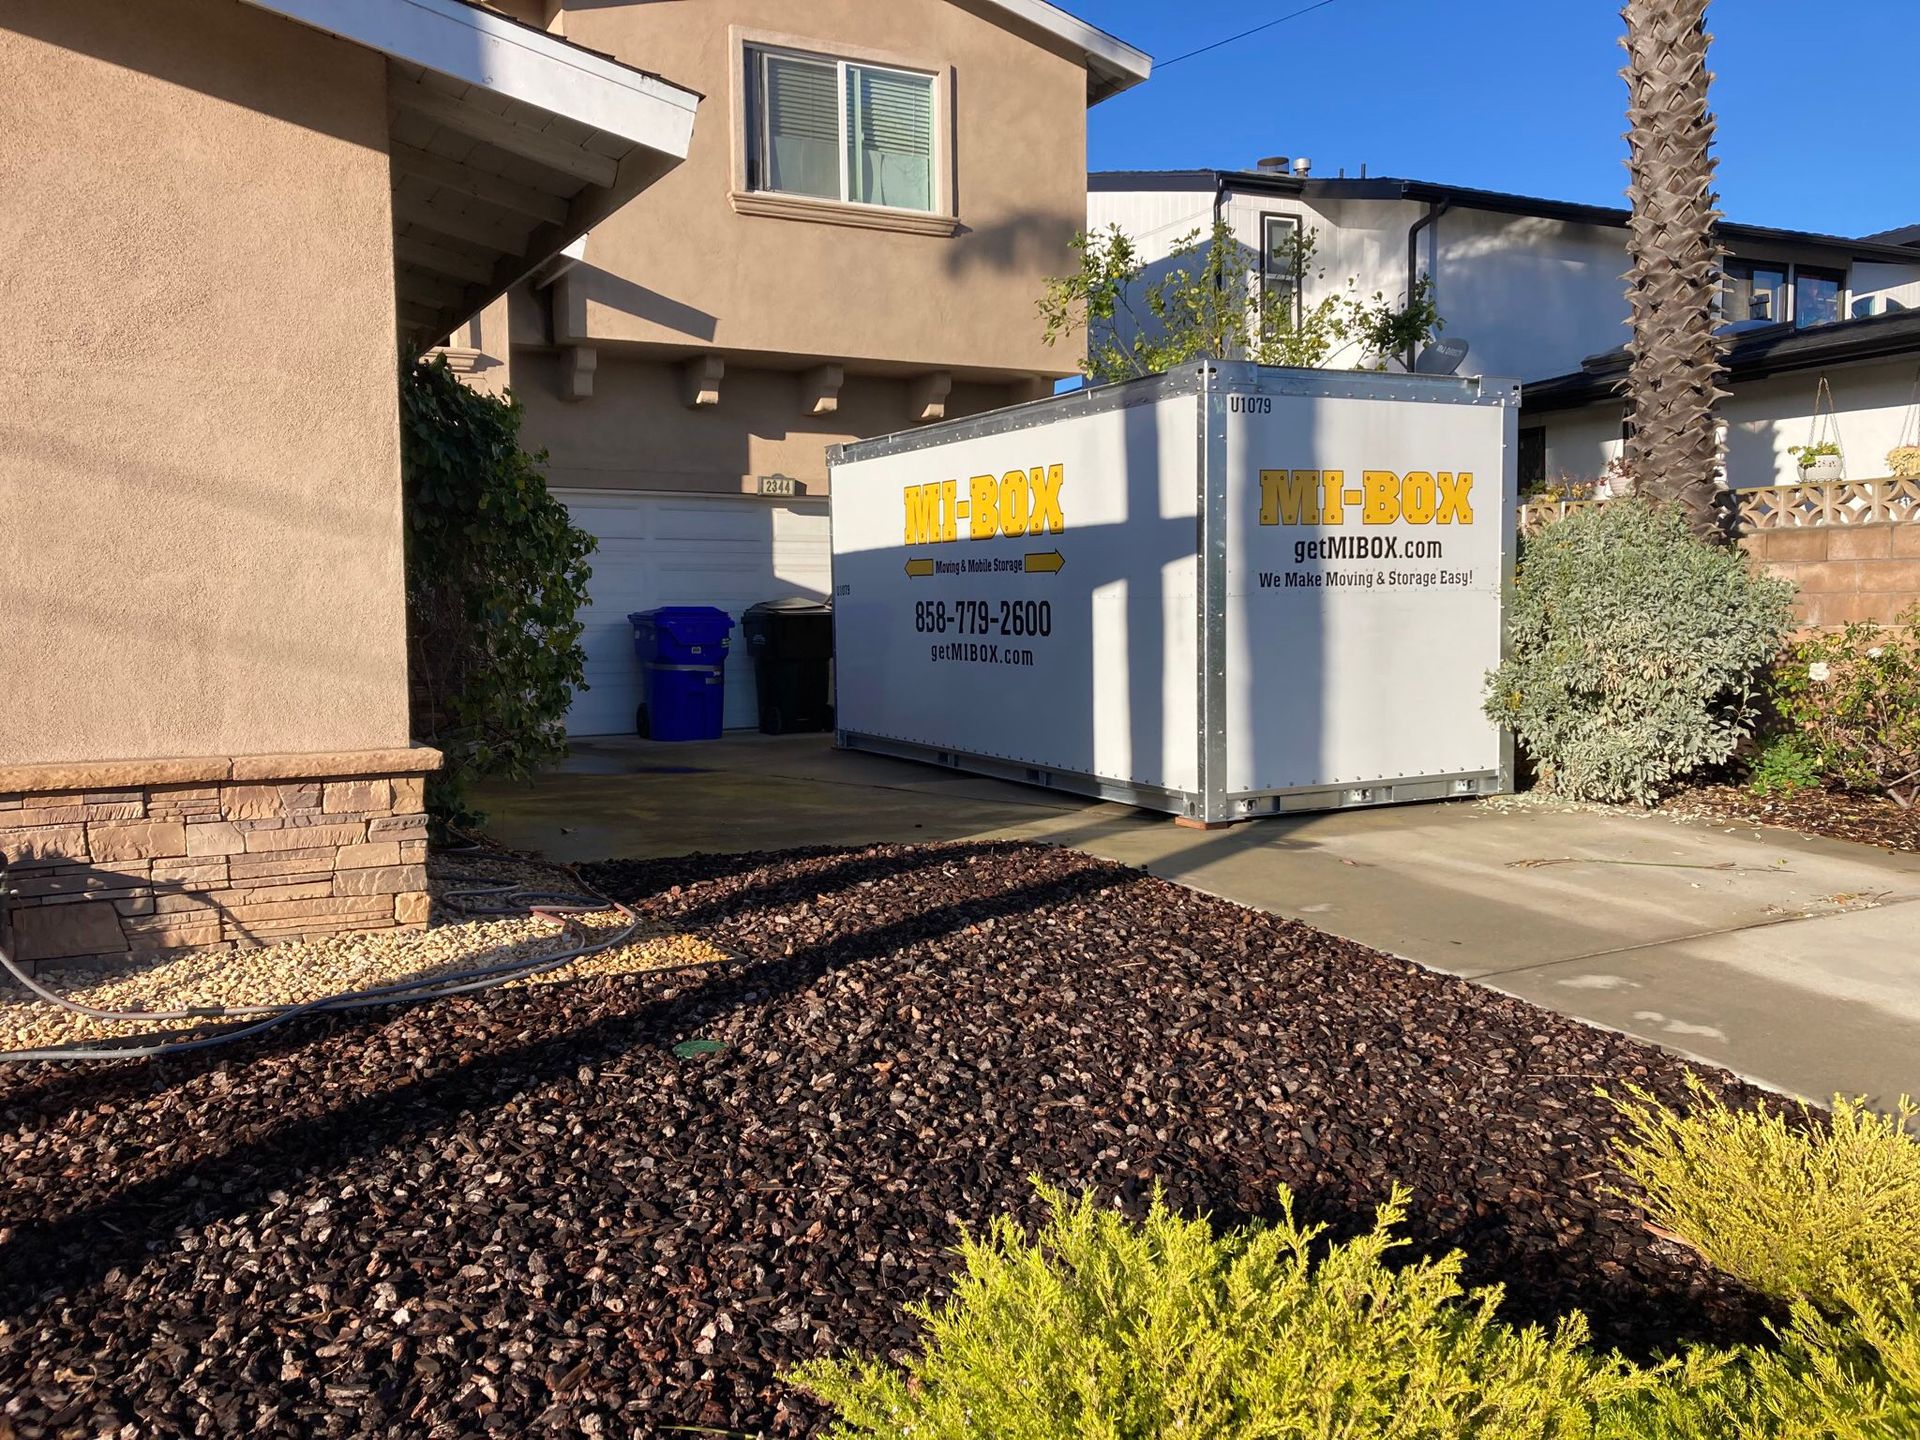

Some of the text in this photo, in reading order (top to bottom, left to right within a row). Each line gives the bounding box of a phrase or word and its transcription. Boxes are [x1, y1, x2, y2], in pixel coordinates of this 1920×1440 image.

[1231, 397, 1271, 413] U1079
[766, 480, 790, 493] 2344
[1260, 470, 1473, 525] MI-BOX
[904, 463, 1064, 546] MI-BOX
[1294, 536, 1443, 563] getMIBOX.com
[935, 557, 1023, 576] Moving & Mobile Storage
[1259, 570, 1473, 588] We Make Moving & Storage Easy!
[915, 600, 1052, 637] 858-779-2600
[931, 643, 1034, 666] getMIBOX.com
